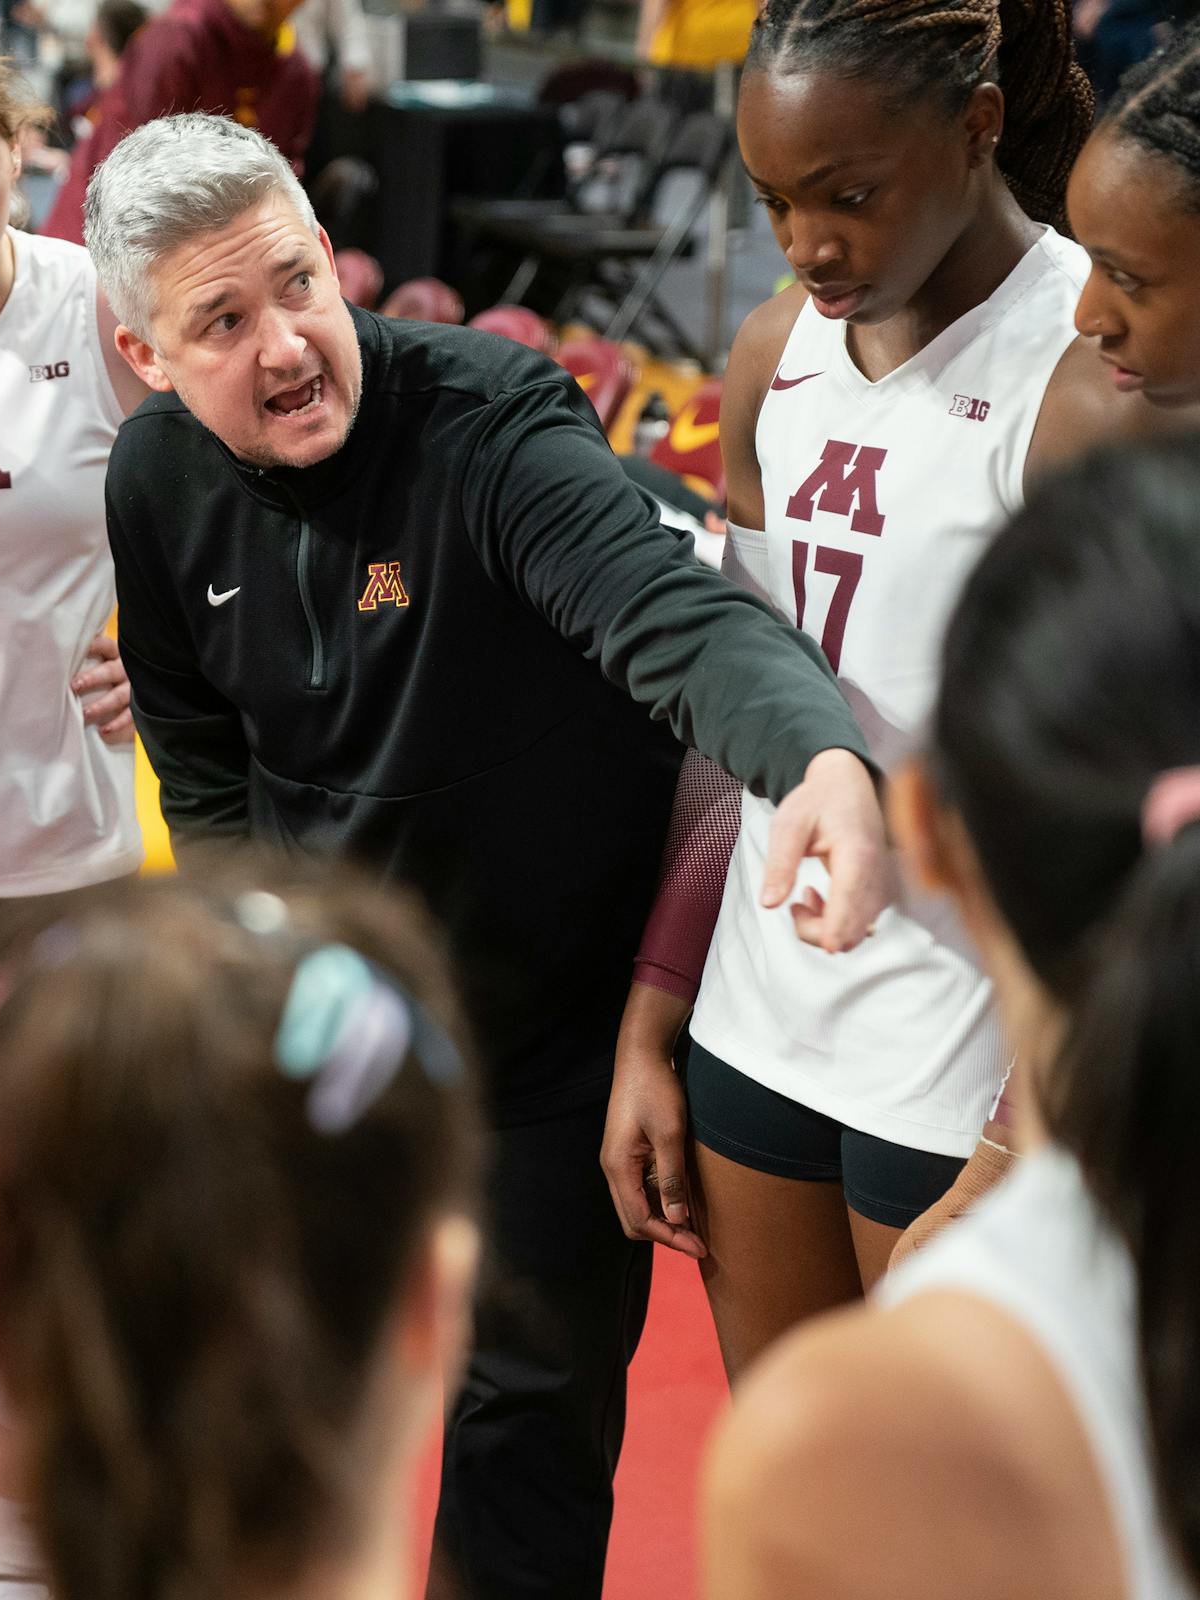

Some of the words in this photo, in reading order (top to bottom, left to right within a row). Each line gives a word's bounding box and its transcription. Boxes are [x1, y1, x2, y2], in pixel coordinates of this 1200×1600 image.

[786, 439, 888, 537] M
[358, 562, 410, 611] M
[792, 539, 864, 677] 17
